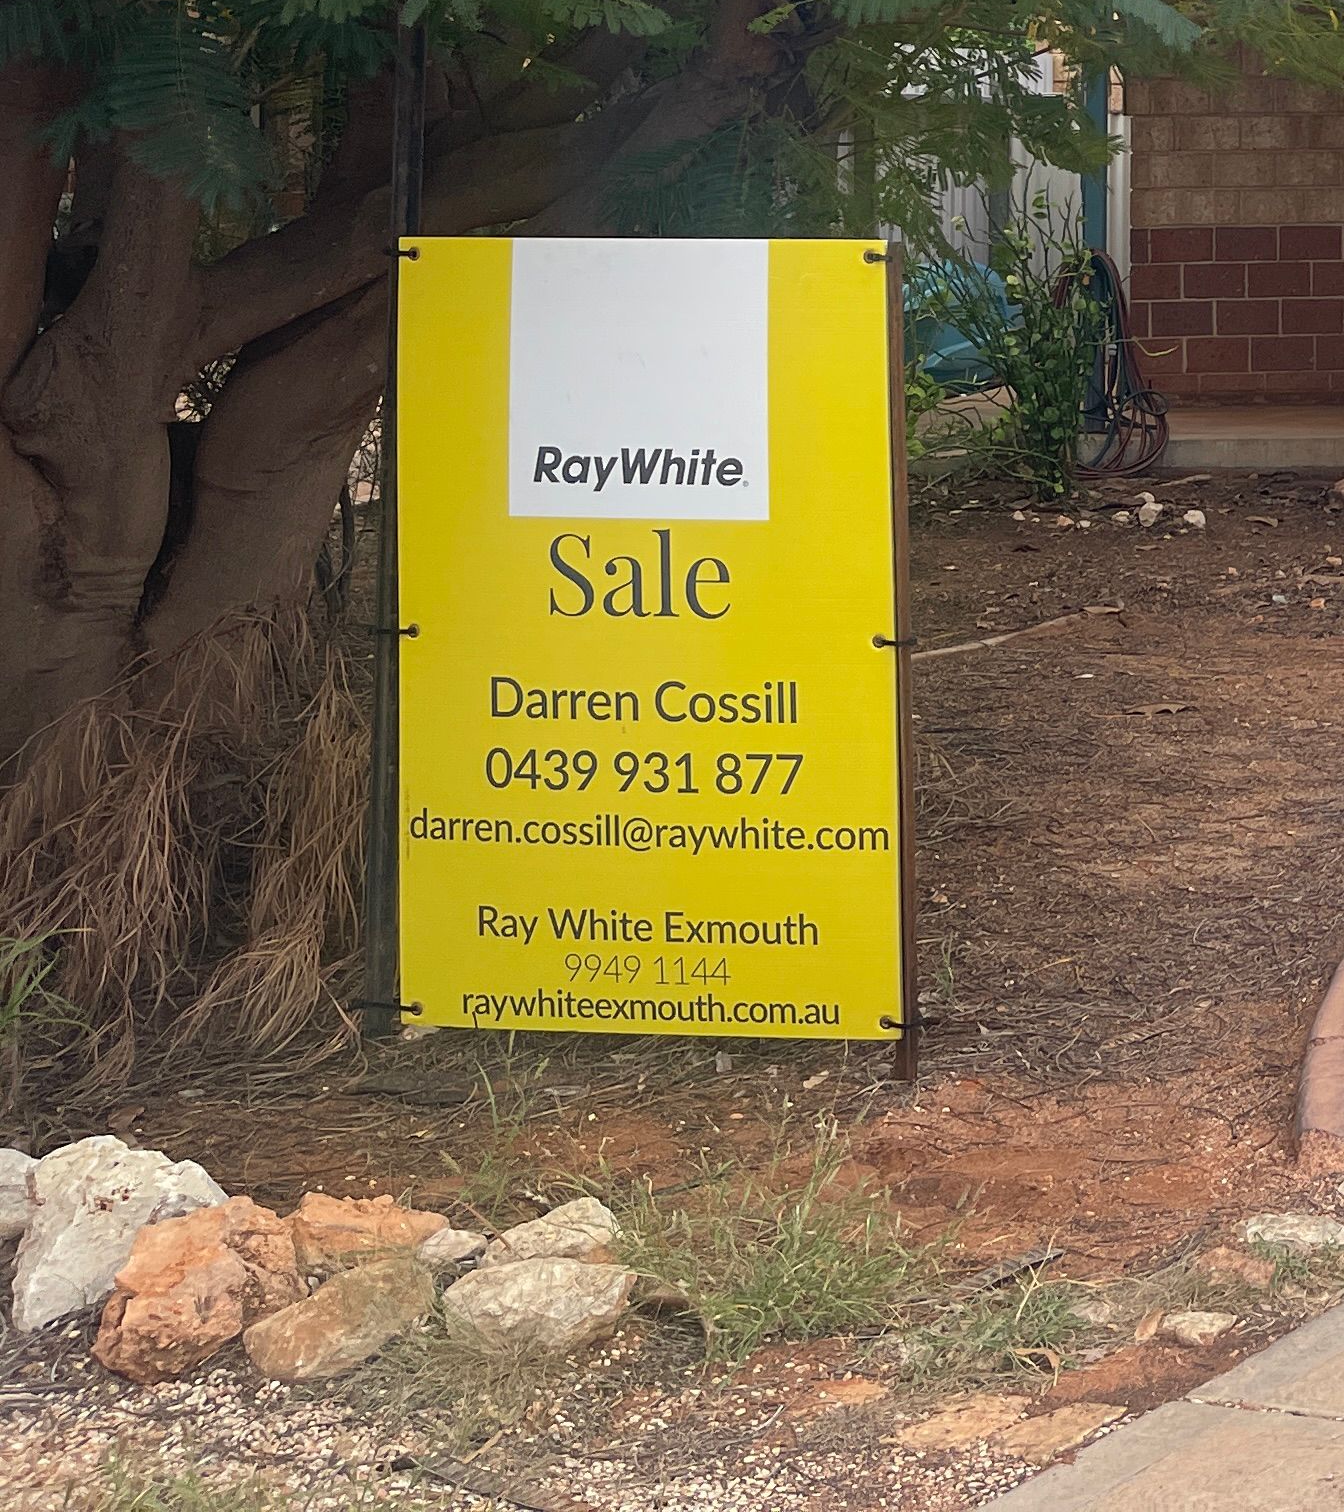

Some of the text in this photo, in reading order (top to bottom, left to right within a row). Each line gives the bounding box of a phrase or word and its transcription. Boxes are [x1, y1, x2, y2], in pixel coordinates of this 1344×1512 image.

[549, 529, 731, 620] Sale
[490, 676, 798, 724] Darren Cossill
[485, 747, 804, 795] 0439 931 877
[409, 807, 890, 856] darren.cossill@raywhite.com
[478, 905, 819, 946] Ray White Exmouth
[564, 953, 732, 986] 9949 1144
[461, 988, 840, 1026] raywhiteexmouth.com.au
